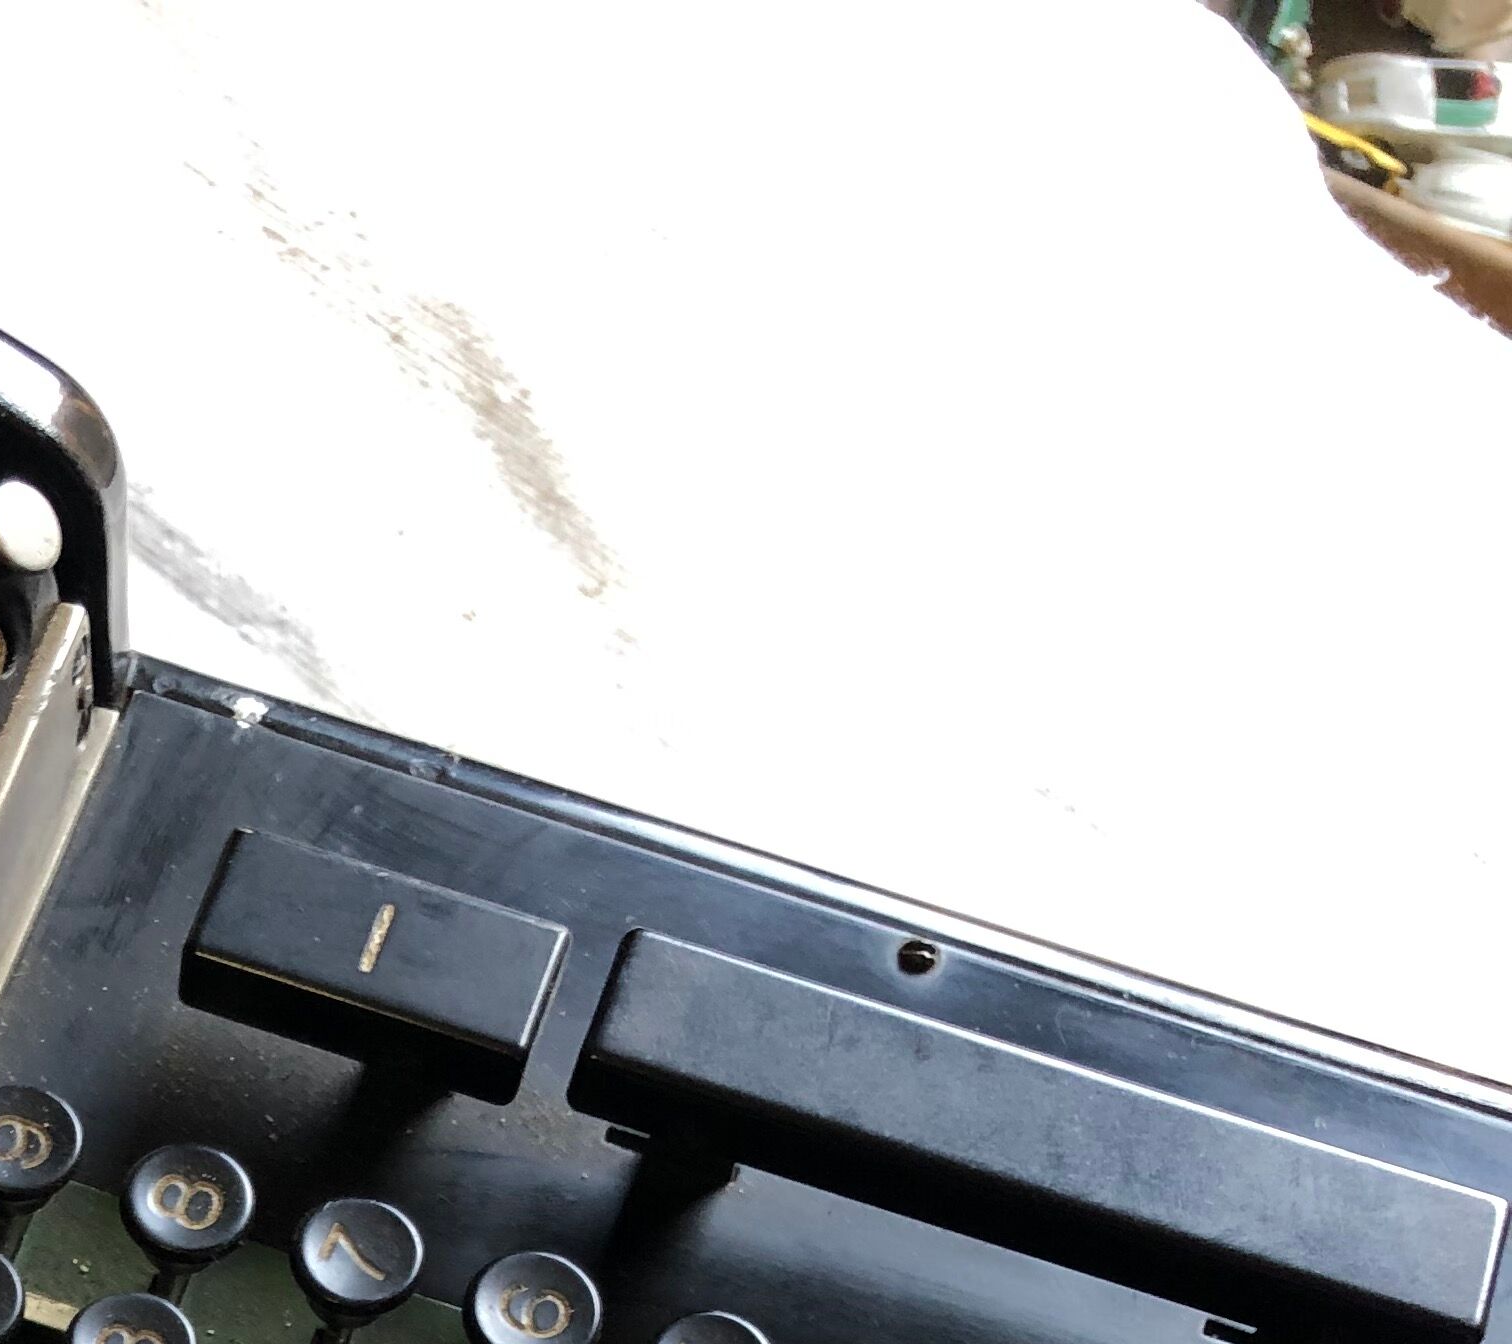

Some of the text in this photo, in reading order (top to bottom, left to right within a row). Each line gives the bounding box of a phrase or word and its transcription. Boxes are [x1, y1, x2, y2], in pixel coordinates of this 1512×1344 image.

[152, 1172, 222, 1231] 8
[321, 1222, 387, 1281] 7
[500, 1281, 571, 1339] 6
